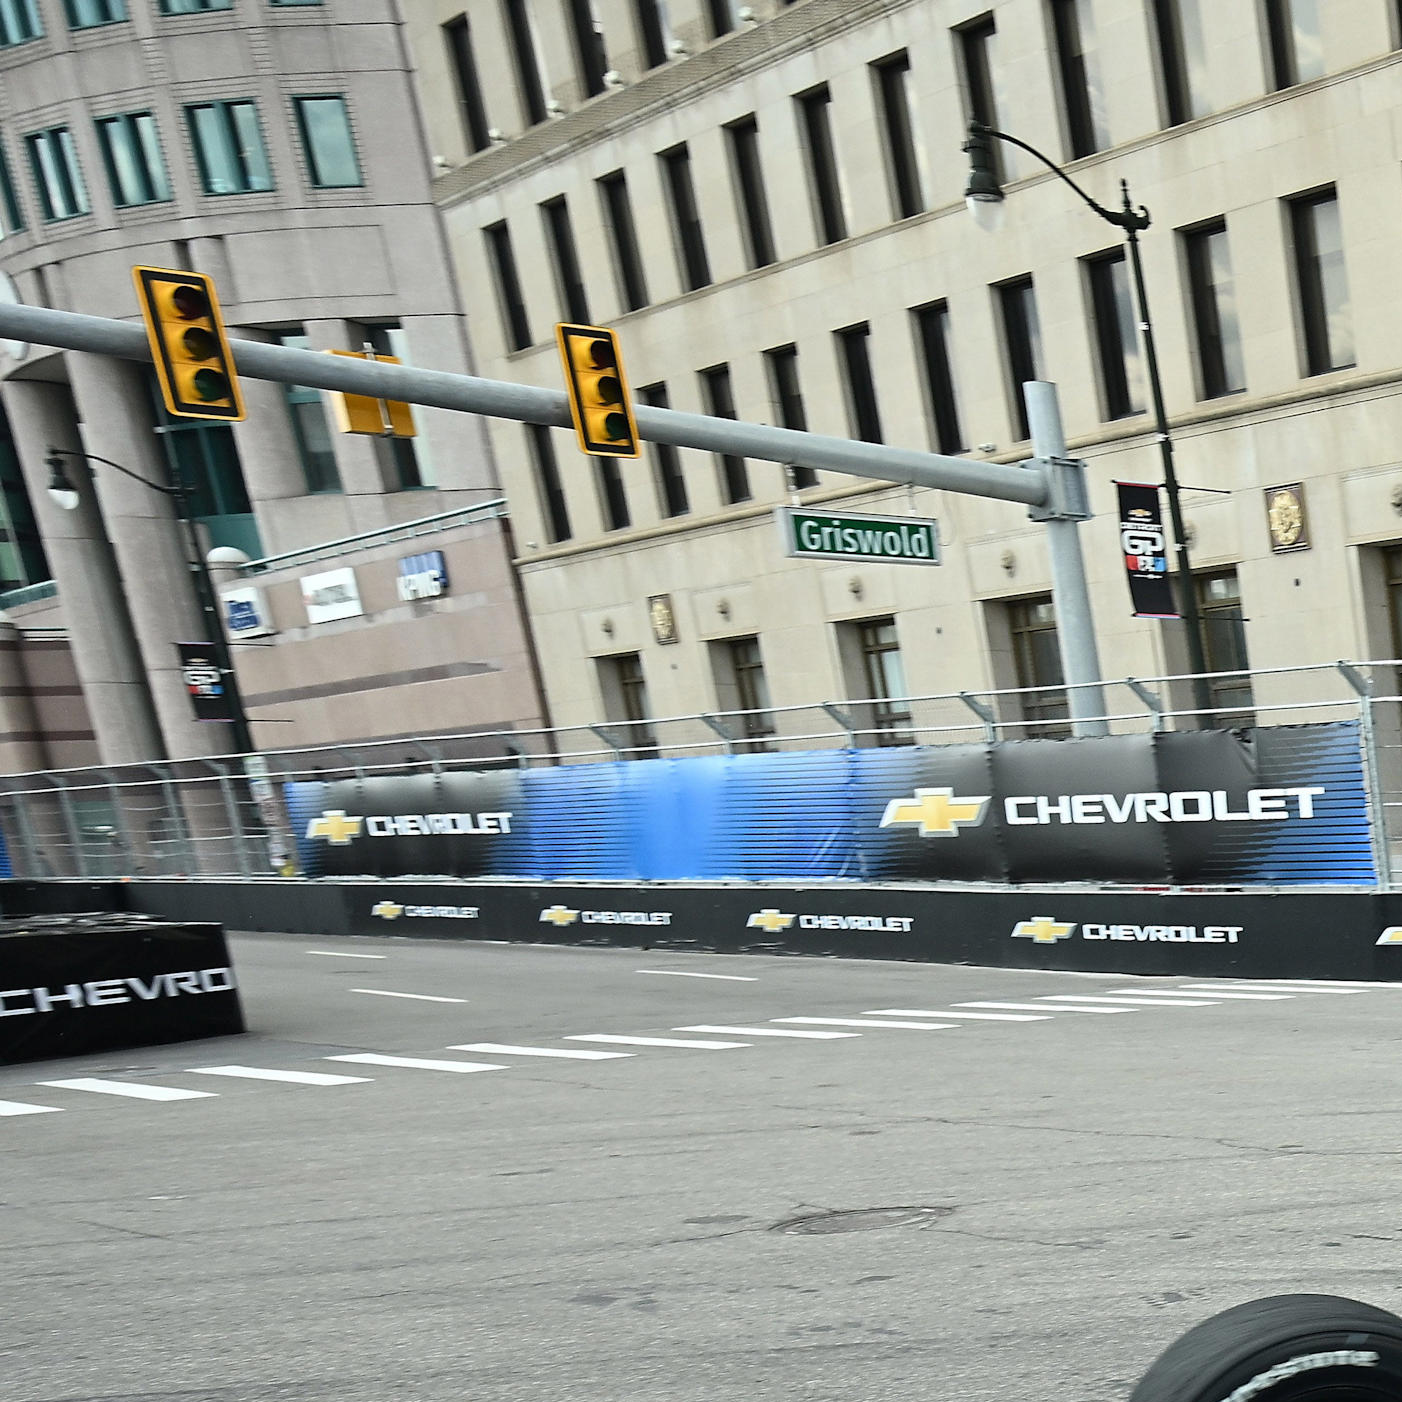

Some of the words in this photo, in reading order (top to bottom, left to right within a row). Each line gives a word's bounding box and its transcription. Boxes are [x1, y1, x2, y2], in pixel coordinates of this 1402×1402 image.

[800, 519, 930, 557] Griswold
[1004, 787, 1326, 825] CHEVROLET
[366, 811, 513, 836] CHEVROLET
[405, 905, 480, 919] CHEVROLET
[580, 911, 673, 926] CHEVROLET
[799, 914, 914, 932] CHEVROLET
[1081, 922, 1243, 943] CHEVROLET
